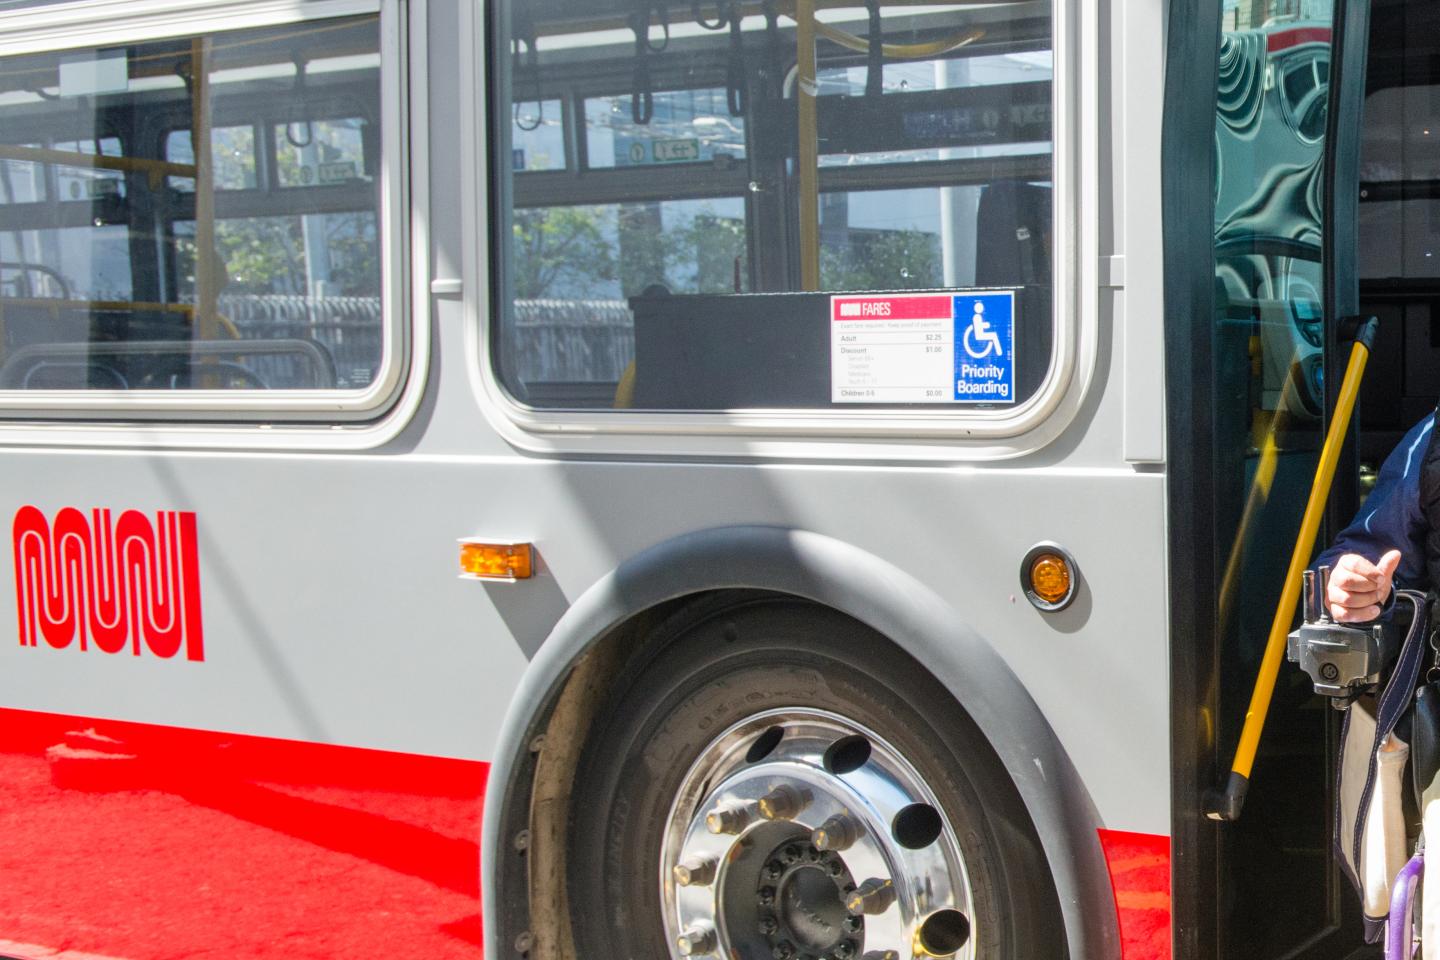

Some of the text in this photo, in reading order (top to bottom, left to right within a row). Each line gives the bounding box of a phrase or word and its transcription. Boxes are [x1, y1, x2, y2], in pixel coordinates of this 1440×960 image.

[862, 302, 891, 316] FARES
[961, 363, 1005, 380] Priority
[957, 380, 1008, 397] Boarding
